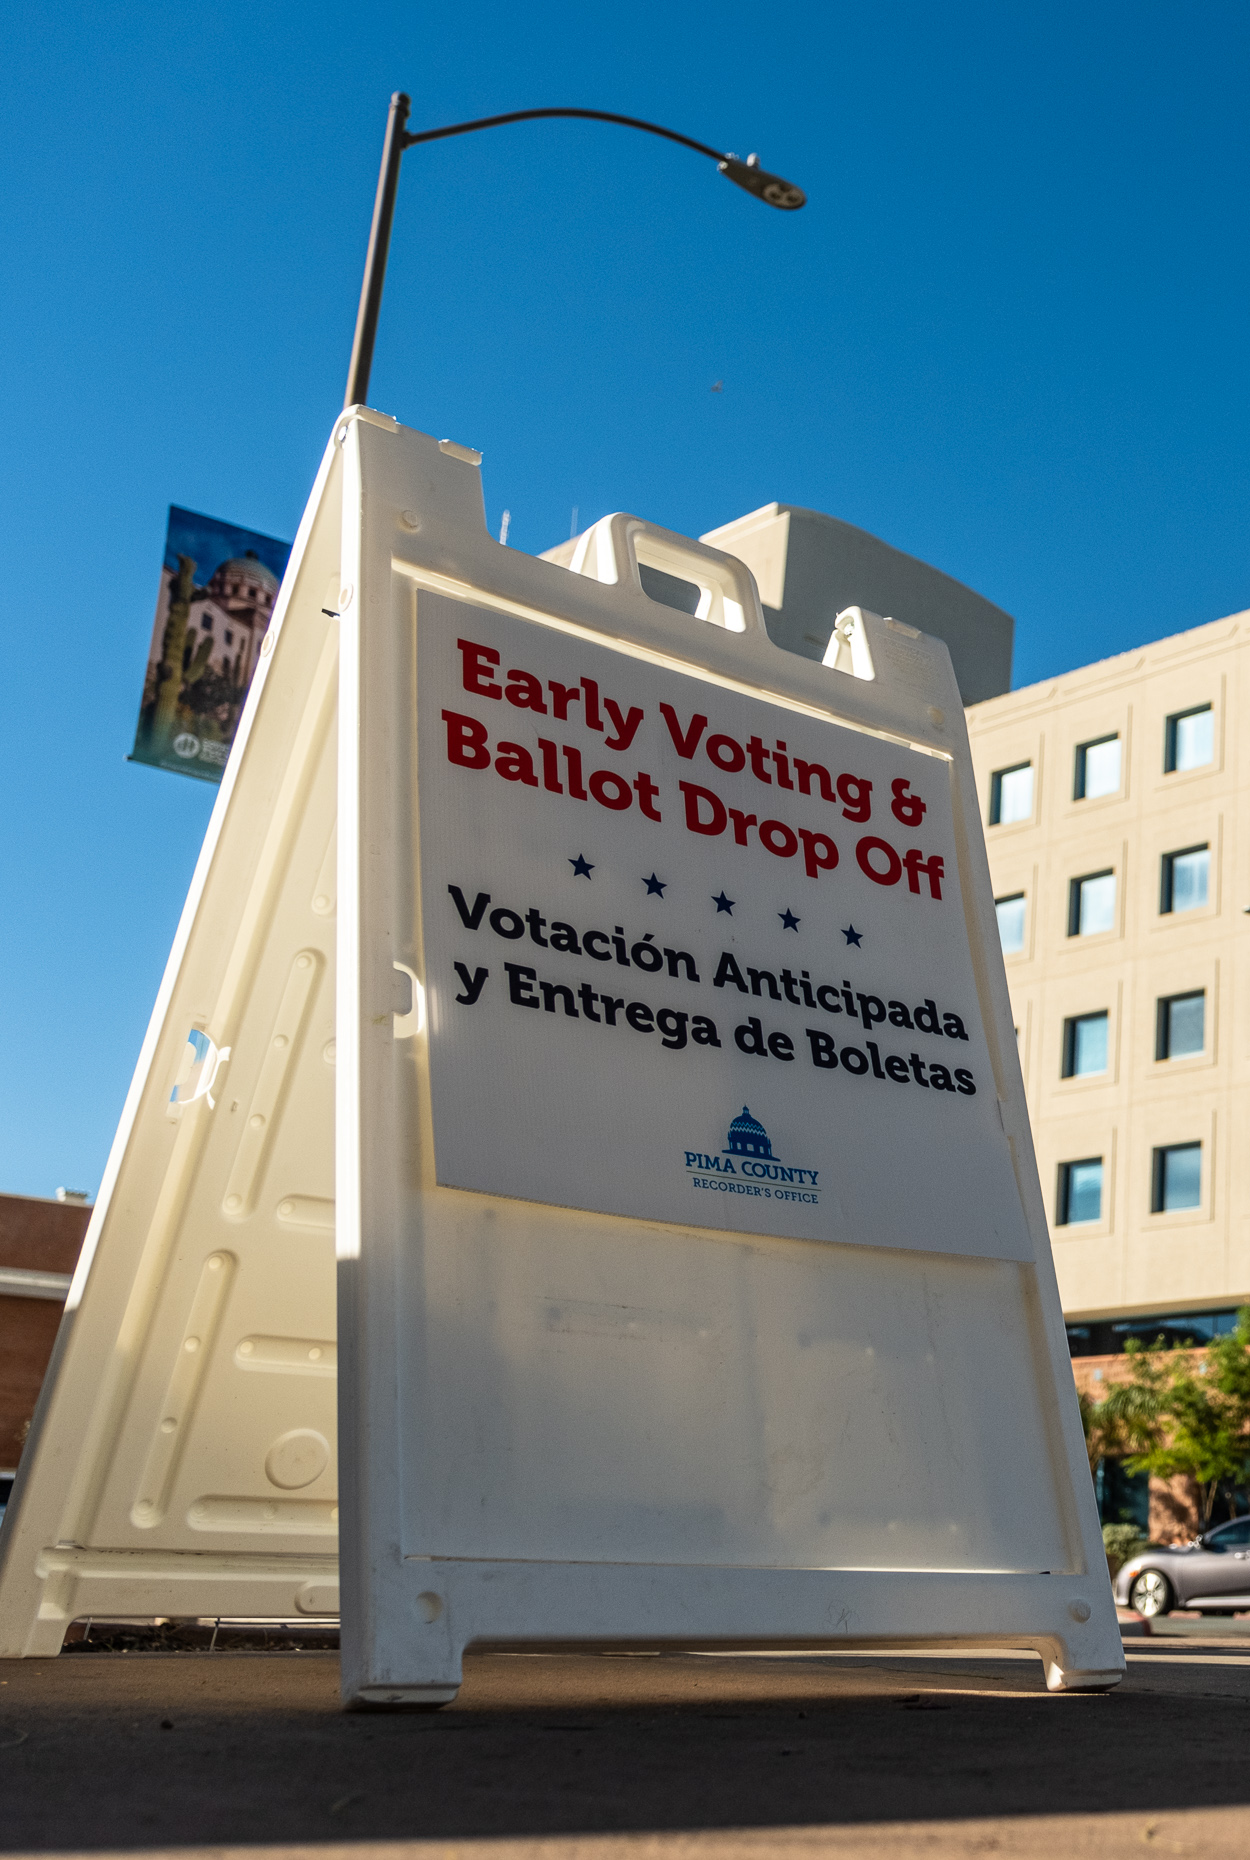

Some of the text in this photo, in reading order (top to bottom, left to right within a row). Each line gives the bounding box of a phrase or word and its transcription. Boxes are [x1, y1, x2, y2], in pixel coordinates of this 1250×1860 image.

[442, 709, 946, 901] Ballot Drop Off
[457, 638, 927, 828] Early Voting &
[447, 884, 970, 1042] Votación Anticipada
[453, 961, 977, 1097] y Entrega de Boletas
[684, 1151, 820, 1186] PIMA COUNTY
[692, 1177, 819, 1204] RECORDER'S OFFICE
